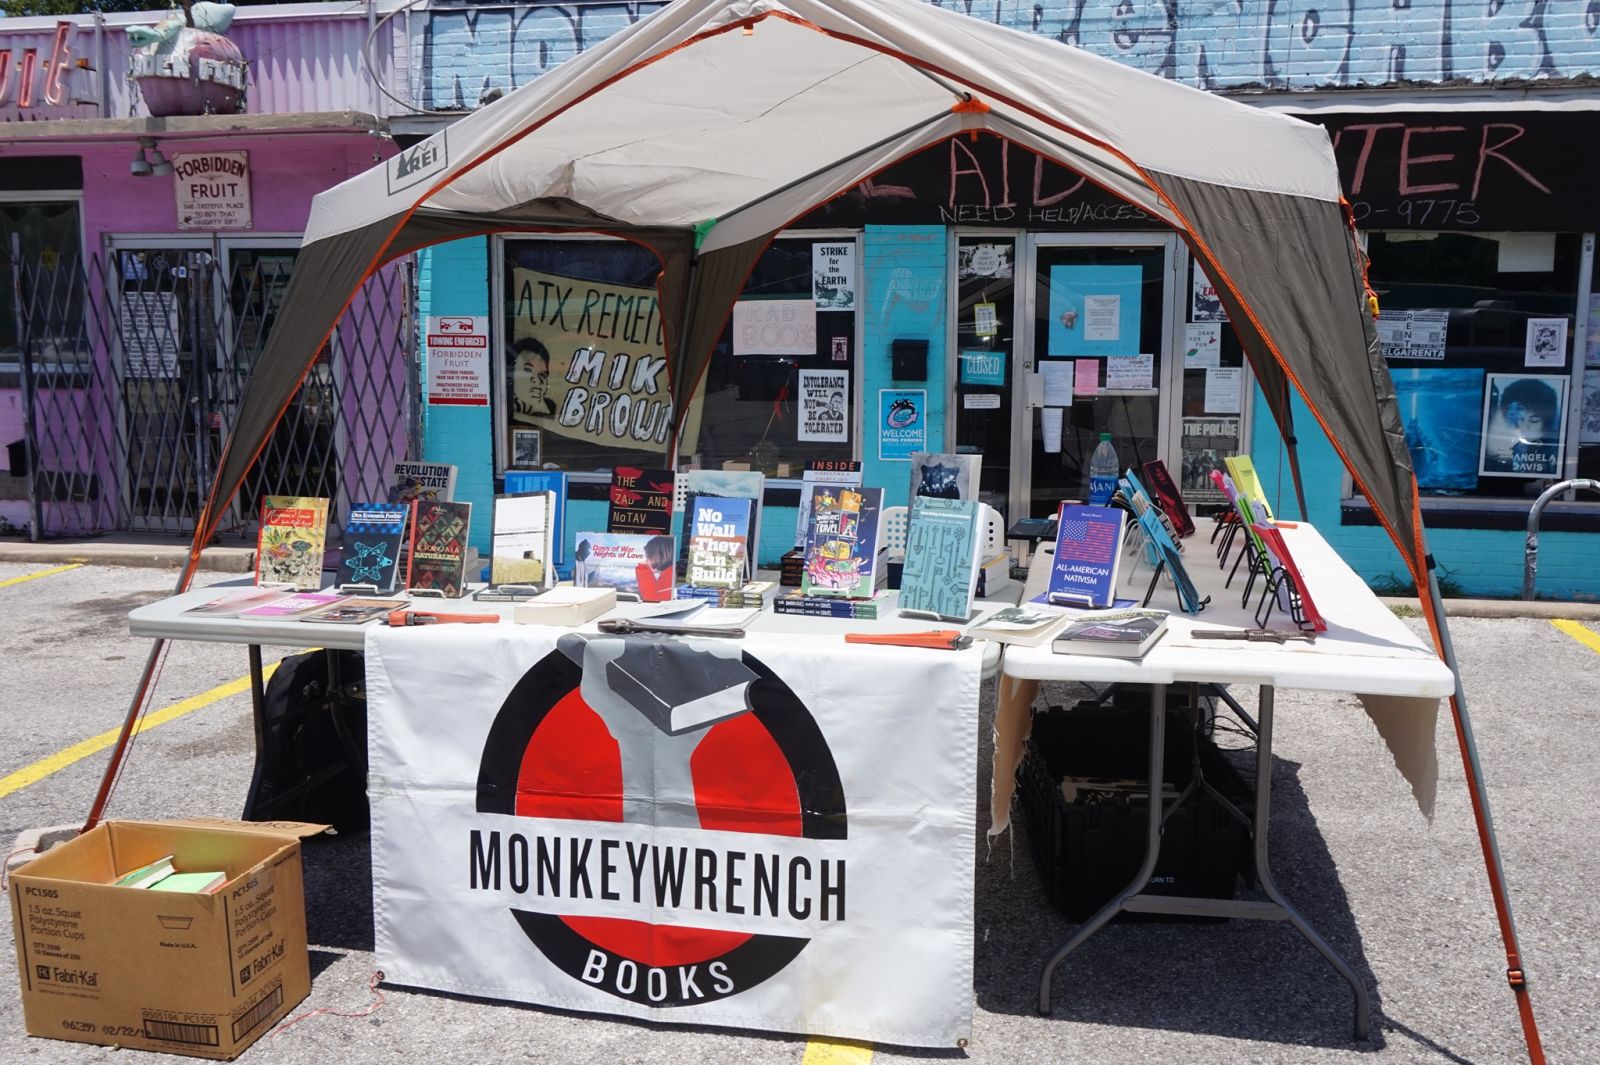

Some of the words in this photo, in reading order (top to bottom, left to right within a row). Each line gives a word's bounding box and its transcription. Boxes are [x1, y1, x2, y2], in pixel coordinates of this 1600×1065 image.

[408, 146, 438, 174] REI
[1333, 122, 1552, 201] TER
[176, 156, 246, 181] FORBIDDEN
[190, 183, 238, 198] FRUIT
[939, 204, 1016, 222] NEED
[820, 246, 848, 256] STRIKE
[821, 276, 847, 286] EARTH
[517, 279, 573, 333] ATX
[746, 303, 798, 322] RAD
[742, 323, 816, 348] BOOKS
[432, 349, 482, 358] FORBIDDEN
[444, 358, 470, 368] FRUIT
[966, 356, 1000, 375] CLOSED
[564, 348, 672, 395] MIK
[803, 376, 845, 388] INTOLERANCE
[806, 389, 828, 398] WILL
[804, 399, 816, 410] NOT
[808, 411, 817, 420] BE
[804, 422, 844, 435] TOLERATED
[882, 429, 924, 438] WELCOME
[1184, 423, 1202, 436] THE
[1203, 423, 1237, 436] POLICE
[1513, 452, 1556, 462] ANGELA
[394, 464, 450, 477] REVOLUTION
[812, 460, 856, 471] INSIDE
[1512, 462, 1544, 472] DAVIS
[420, 476, 448, 488] STATE
[616, 476, 636, 488] THE
[648, 496, 668, 507] AND
[613, 512, 647, 524] NoTAV
[698, 508, 723, 522] No
[696, 522, 736, 538] Wall
[816, 524, 838, 534] TRAVEL
[592, 544, 610, 552] Days
[695, 537, 741, 556] They
[692, 551, 726, 566] Can
[691, 566, 738, 582] Build
[1056, 563, 1110, 576] ALL-AMERICAN
[1064, 574, 1098, 584] NATIVISM
[470, 829, 847, 922] MONKEYWRENCH
[256, 885, 274, 904] Squat
[56, 907, 82, 920] Squat
[235, 898, 272, 929] Polystyrene
[29, 914, 79, 928] Polystyrene
[235, 917, 260, 940] Portion
[260, 905, 278, 922] Cups
[30, 924, 62, 938] Portion
[62, 928, 86, 942] Cups
[54, 967, 100, 986] Fabri-Kal
[581, 948, 735, 1003] BOOKS
